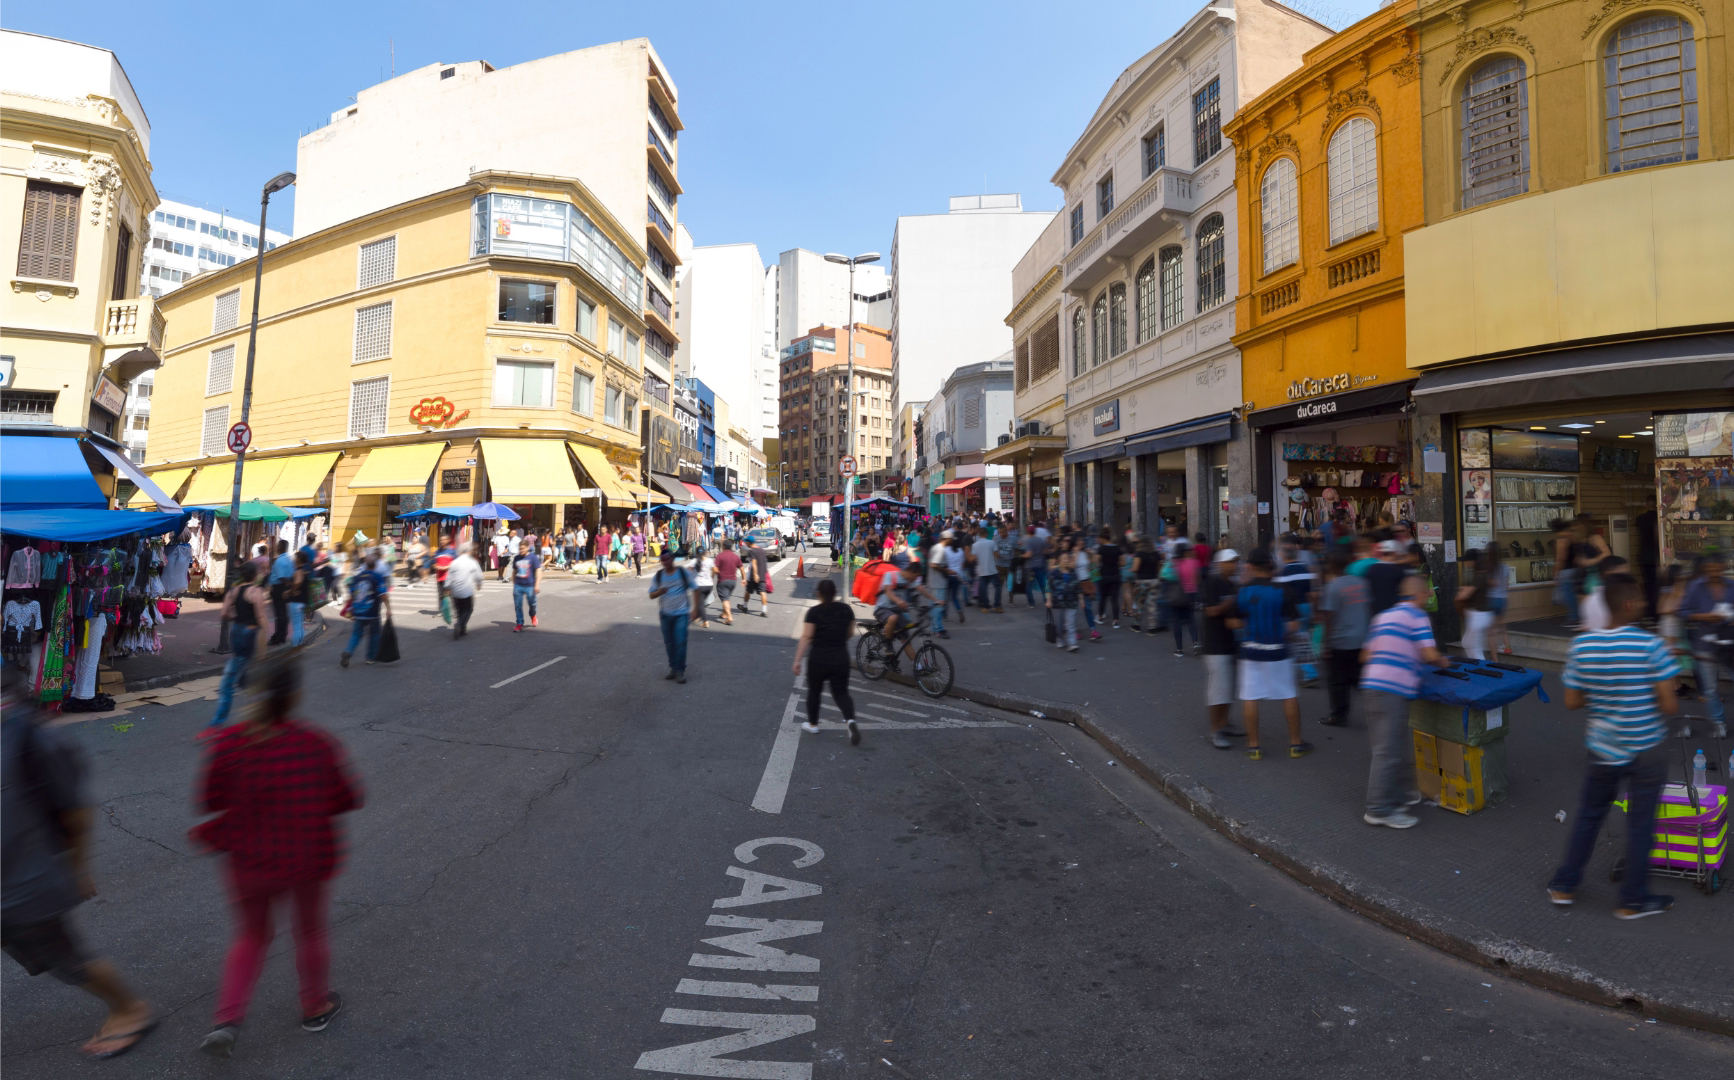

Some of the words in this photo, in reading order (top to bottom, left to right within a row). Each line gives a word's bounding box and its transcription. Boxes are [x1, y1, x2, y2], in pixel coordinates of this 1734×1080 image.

[502, 198, 522, 206] NIAZI
[1286, 372, 1350, 400] duCareca
[1094, 406, 1114, 426] maluli
[1297, 401, 1337, 418] duCareca
